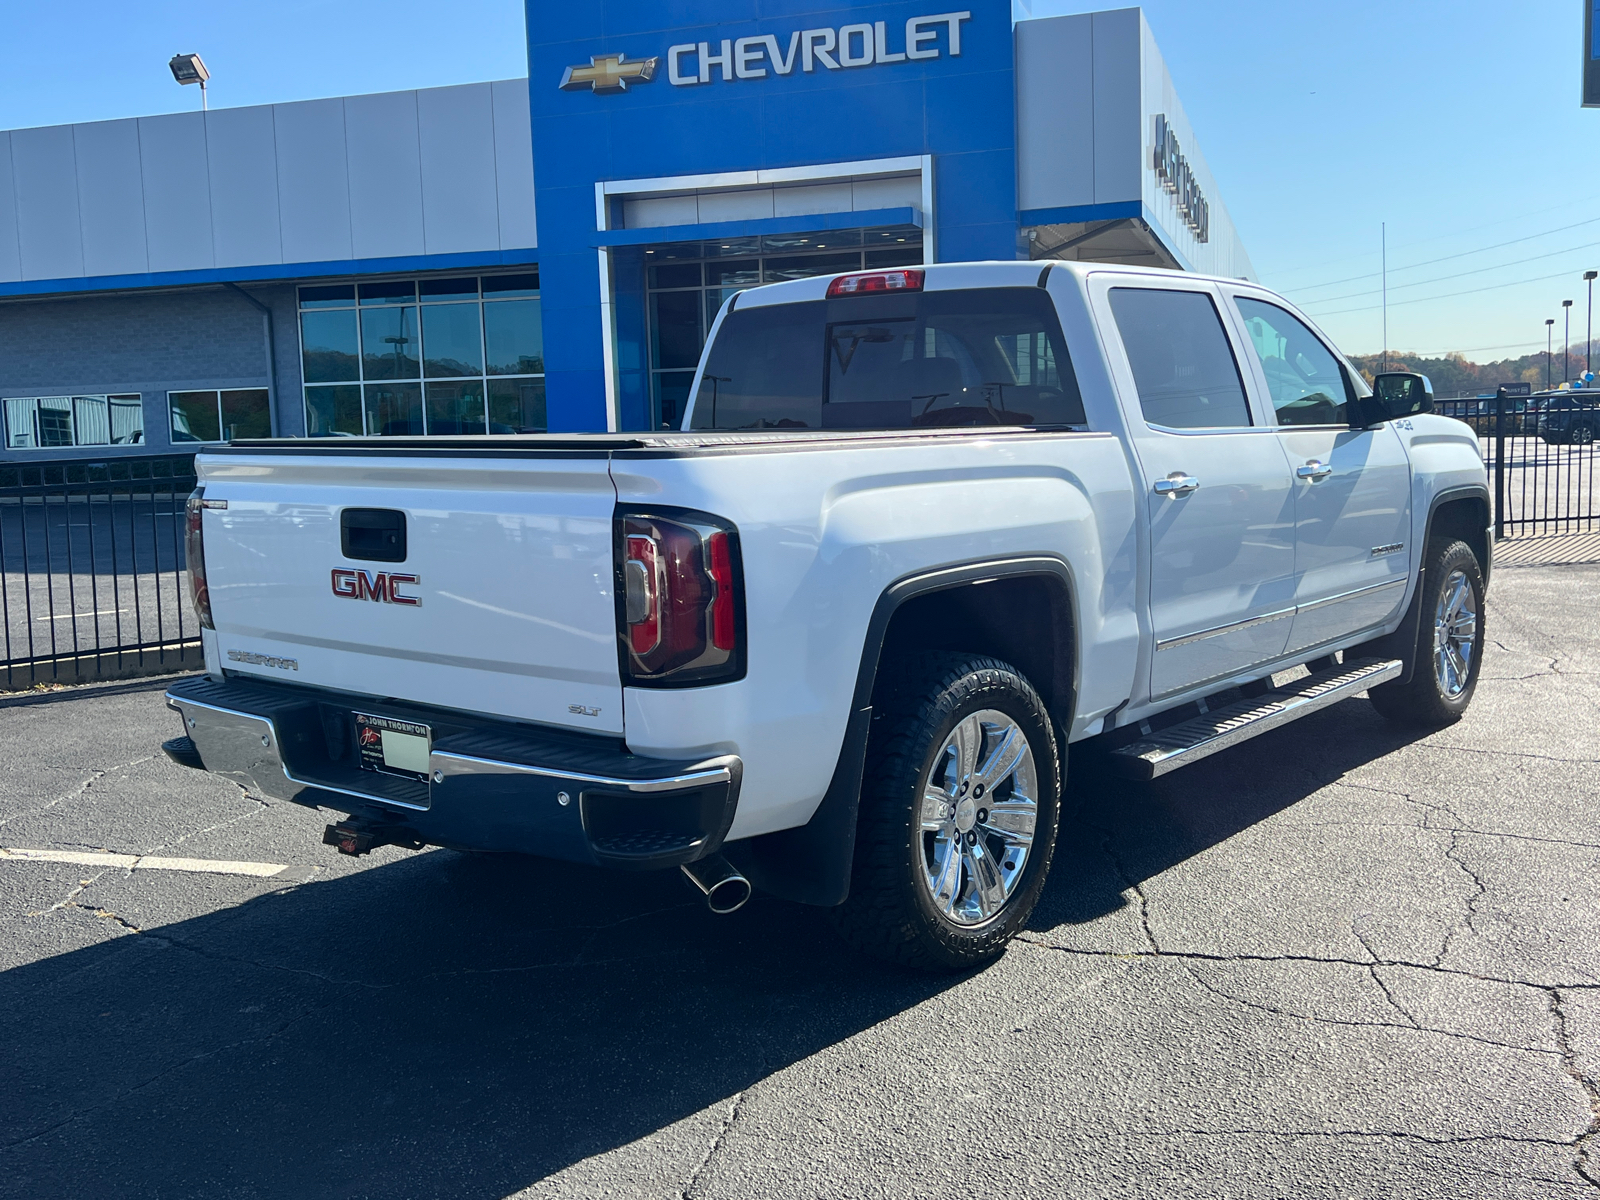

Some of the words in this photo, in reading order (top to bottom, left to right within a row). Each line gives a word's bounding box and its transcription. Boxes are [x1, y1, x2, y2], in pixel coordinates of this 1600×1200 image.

[668, 10, 971, 86] CHEVROLET
[330, 566, 422, 607] GMC
[227, 648, 299, 671] SIERRA
[568, 703, 602, 717] SLT
[369, 716, 387, 728] JOHN
[388, 720, 426, 735] THORNTON
